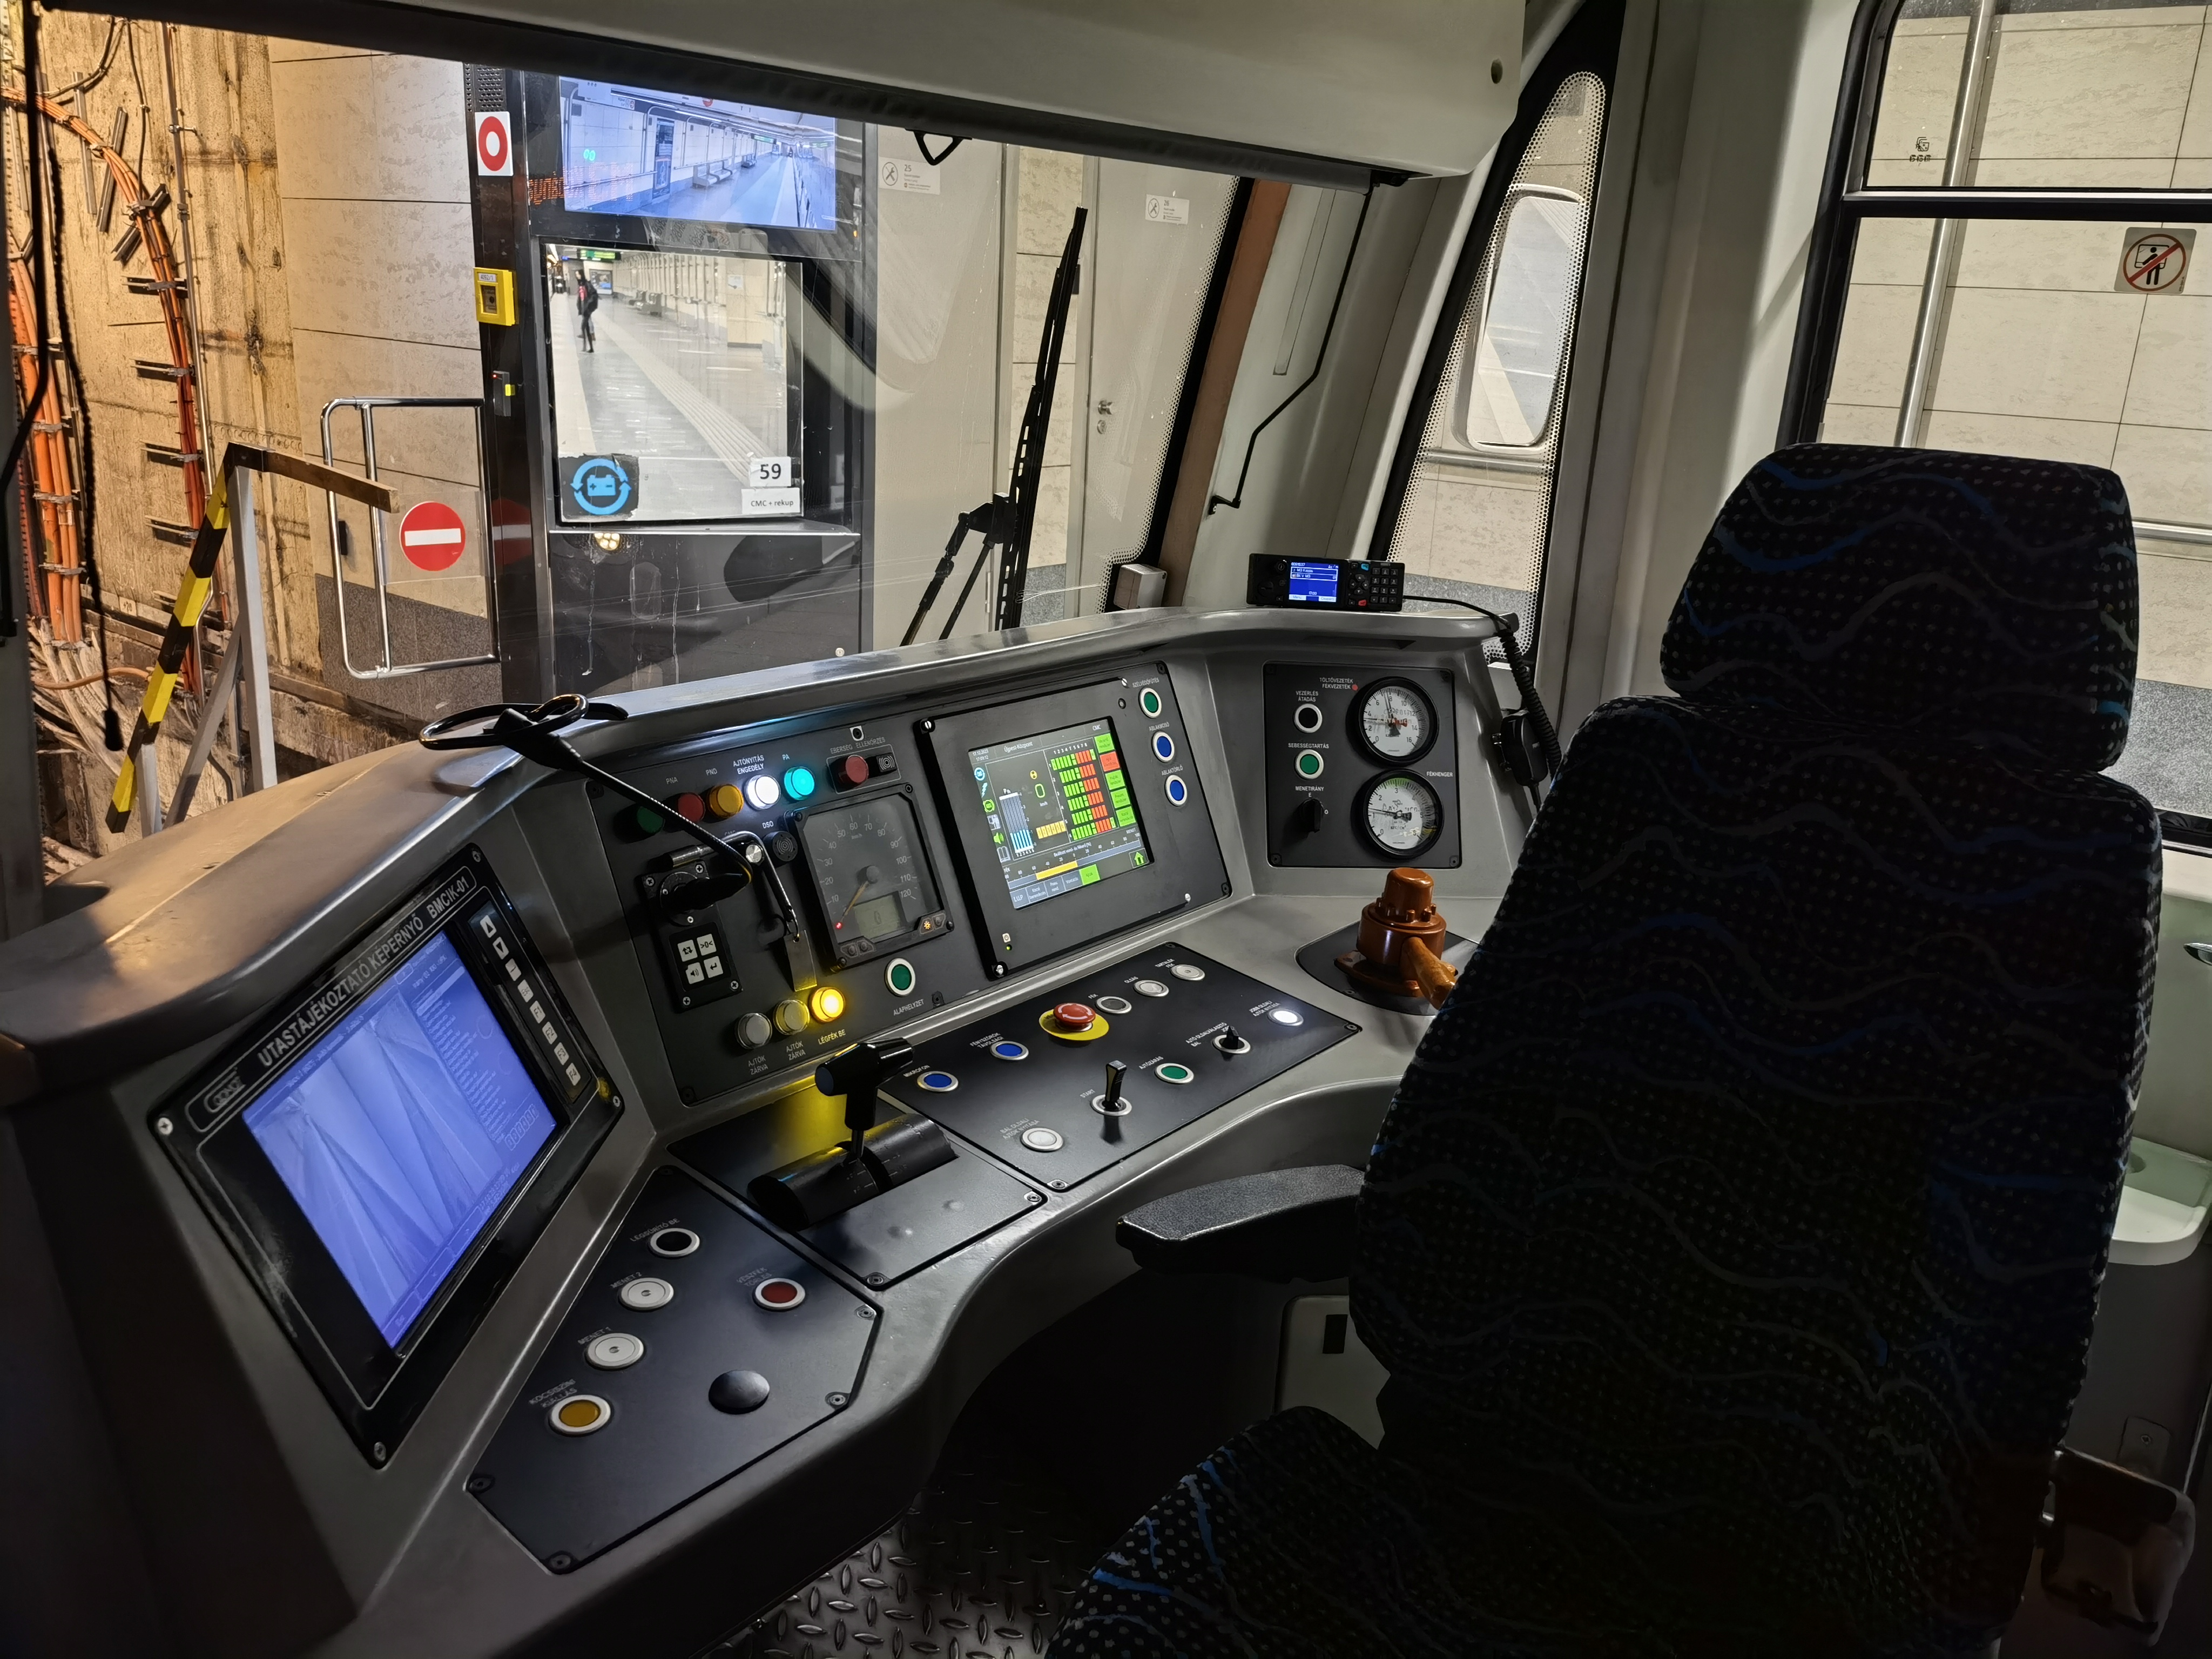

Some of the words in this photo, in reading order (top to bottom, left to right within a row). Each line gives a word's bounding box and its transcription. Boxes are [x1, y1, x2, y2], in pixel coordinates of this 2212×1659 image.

[760, 463, 781, 480] 59
[1003, 741, 1033, 753] Újpest-Központ
[733, 754, 764, 767] AJTÓNYITÁS
[705, 768, 718, 776] PND
[737, 763, 764, 774] ENGEDÉLY
[665, 776, 678, 785] PNA
[762, 820, 774, 829] DSO
[849, 821, 858, 830] 60
[837, 829, 846, 837] 50
[877, 828, 886, 837] 80
[828, 841, 837, 849] 40
[890, 840, 899, 848] 90
[824, 858, 833, 866] 30
[896, 855, 907, 865] 100
[825, 876, 833, 885] 20
[900, 873, 911, 882] 110
[831, 894, 839, 902] 10
[900, 888, 912, 898] 120
[258, 960, 370, 1068] UTASTÁJÉKOZTATÓ
[370, 913, 424, 973] KÉPERNYŐ
[426, 875, 470, 920] BMCIK-01
[533, 1006, 542, 1015] F1
[893, 999, 925, 1016] ALAPHELYZET
[545, 1027, 554, 1037] F2
[818, 1033, 838, 1045] LÉGFÉK
[838, 1029, 846, 1037] BE
[786, 1041, 804, 1053] AJTÓK
[557, 1048, 566, 1059] F3
[788, 1049, 806, 1061] ZÁRVA
[748, 1055, 766, 1067] AJTÓK
[750, 1063, 768, 1075] ZÁRVA
[903, 1064, 930, 1077] MIKROFON
[1080, 1089, 1096, 1098] START
[610, 1274, 635, 1289] MENET
